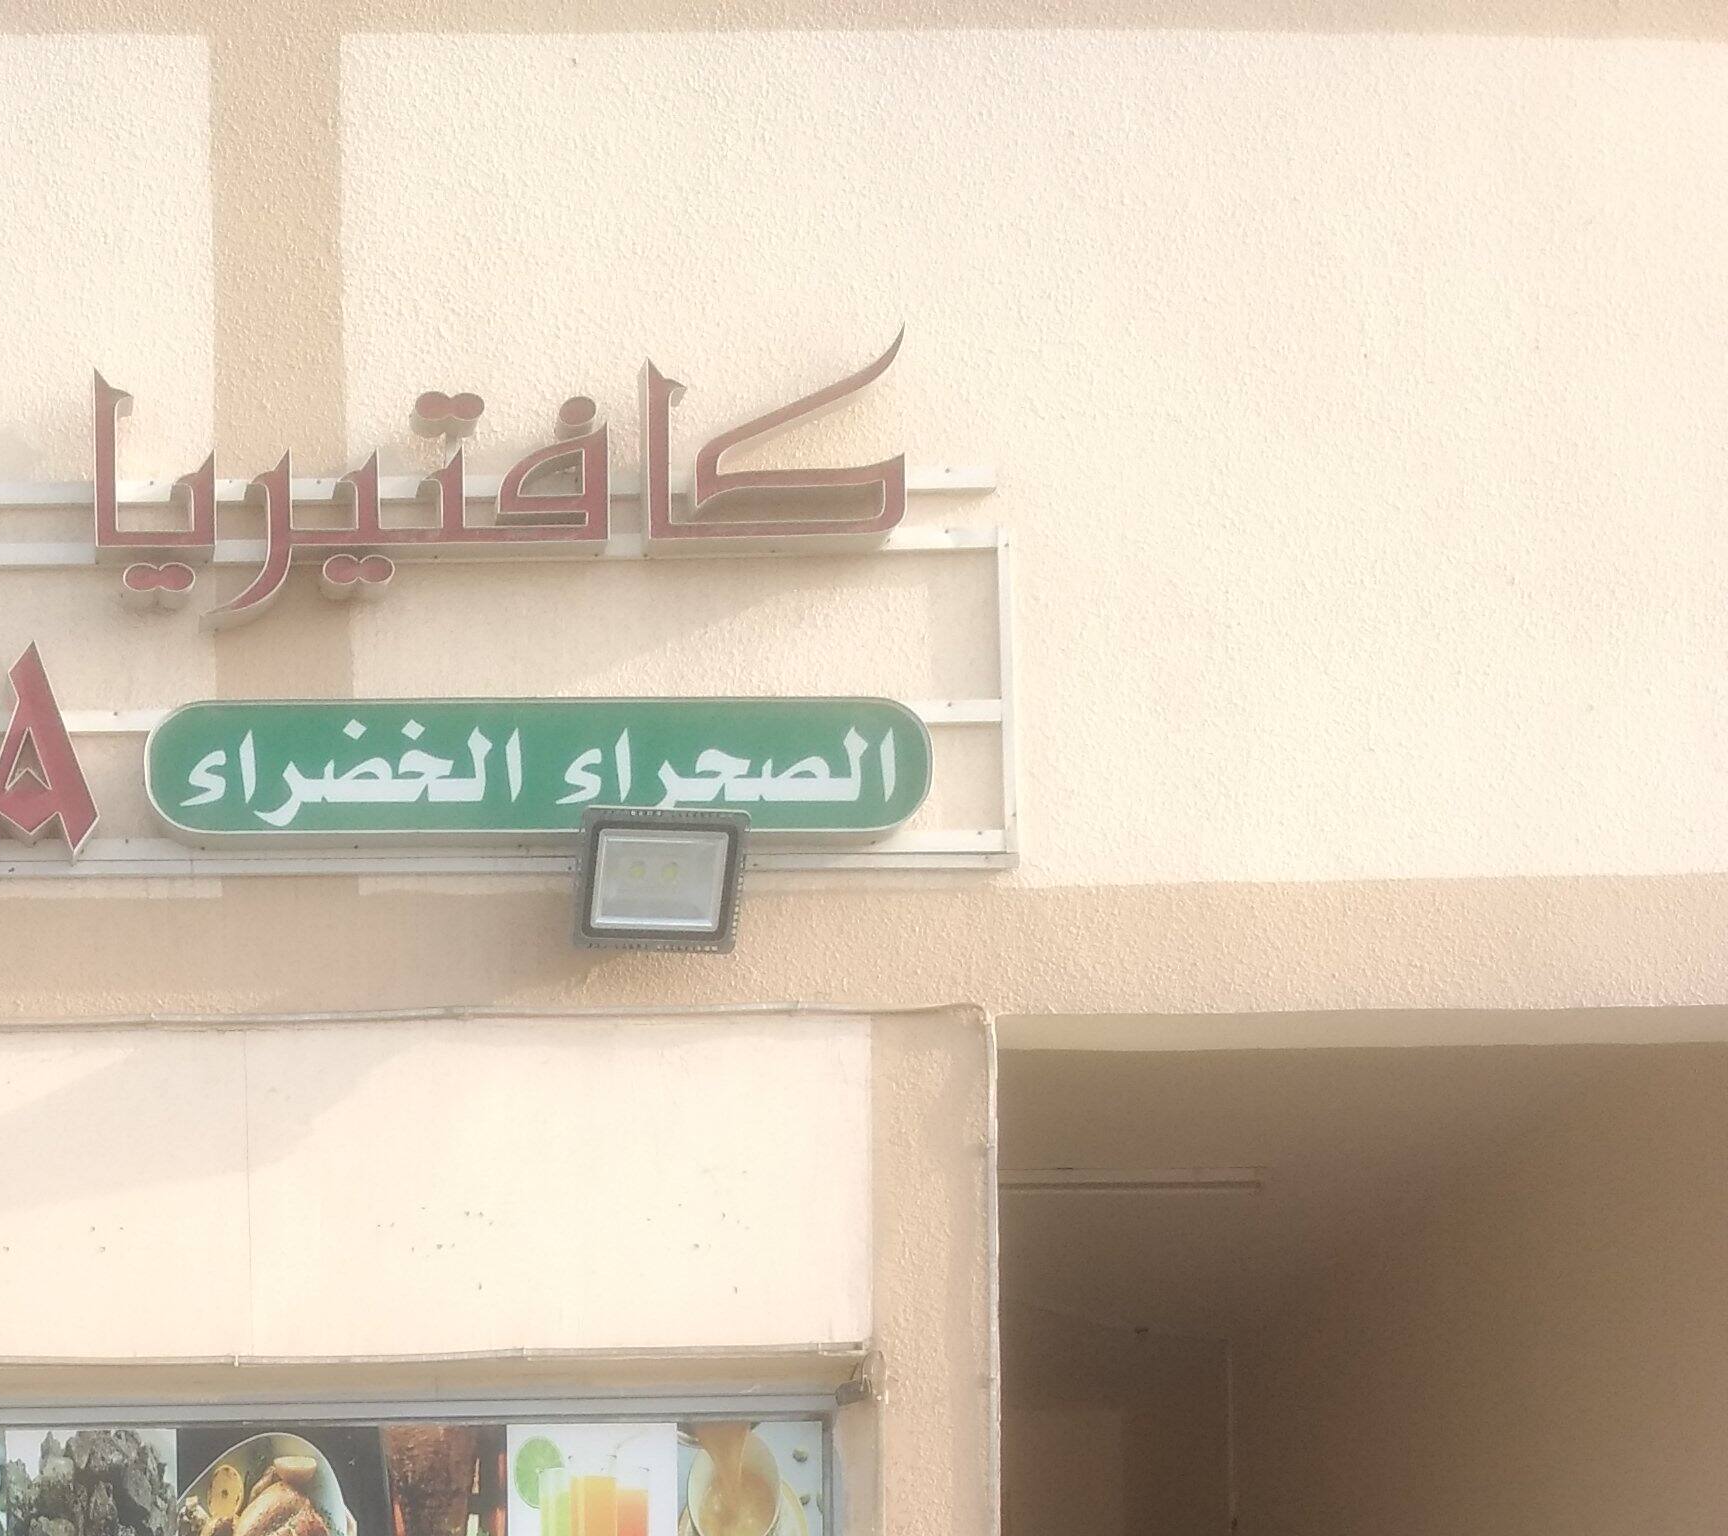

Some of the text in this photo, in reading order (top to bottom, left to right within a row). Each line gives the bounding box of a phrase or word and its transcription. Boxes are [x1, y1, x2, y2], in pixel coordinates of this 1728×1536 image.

[94, 323, 906, 628] كافتيريا
[180, 718, 896, 827] الصحراء الخضراء
